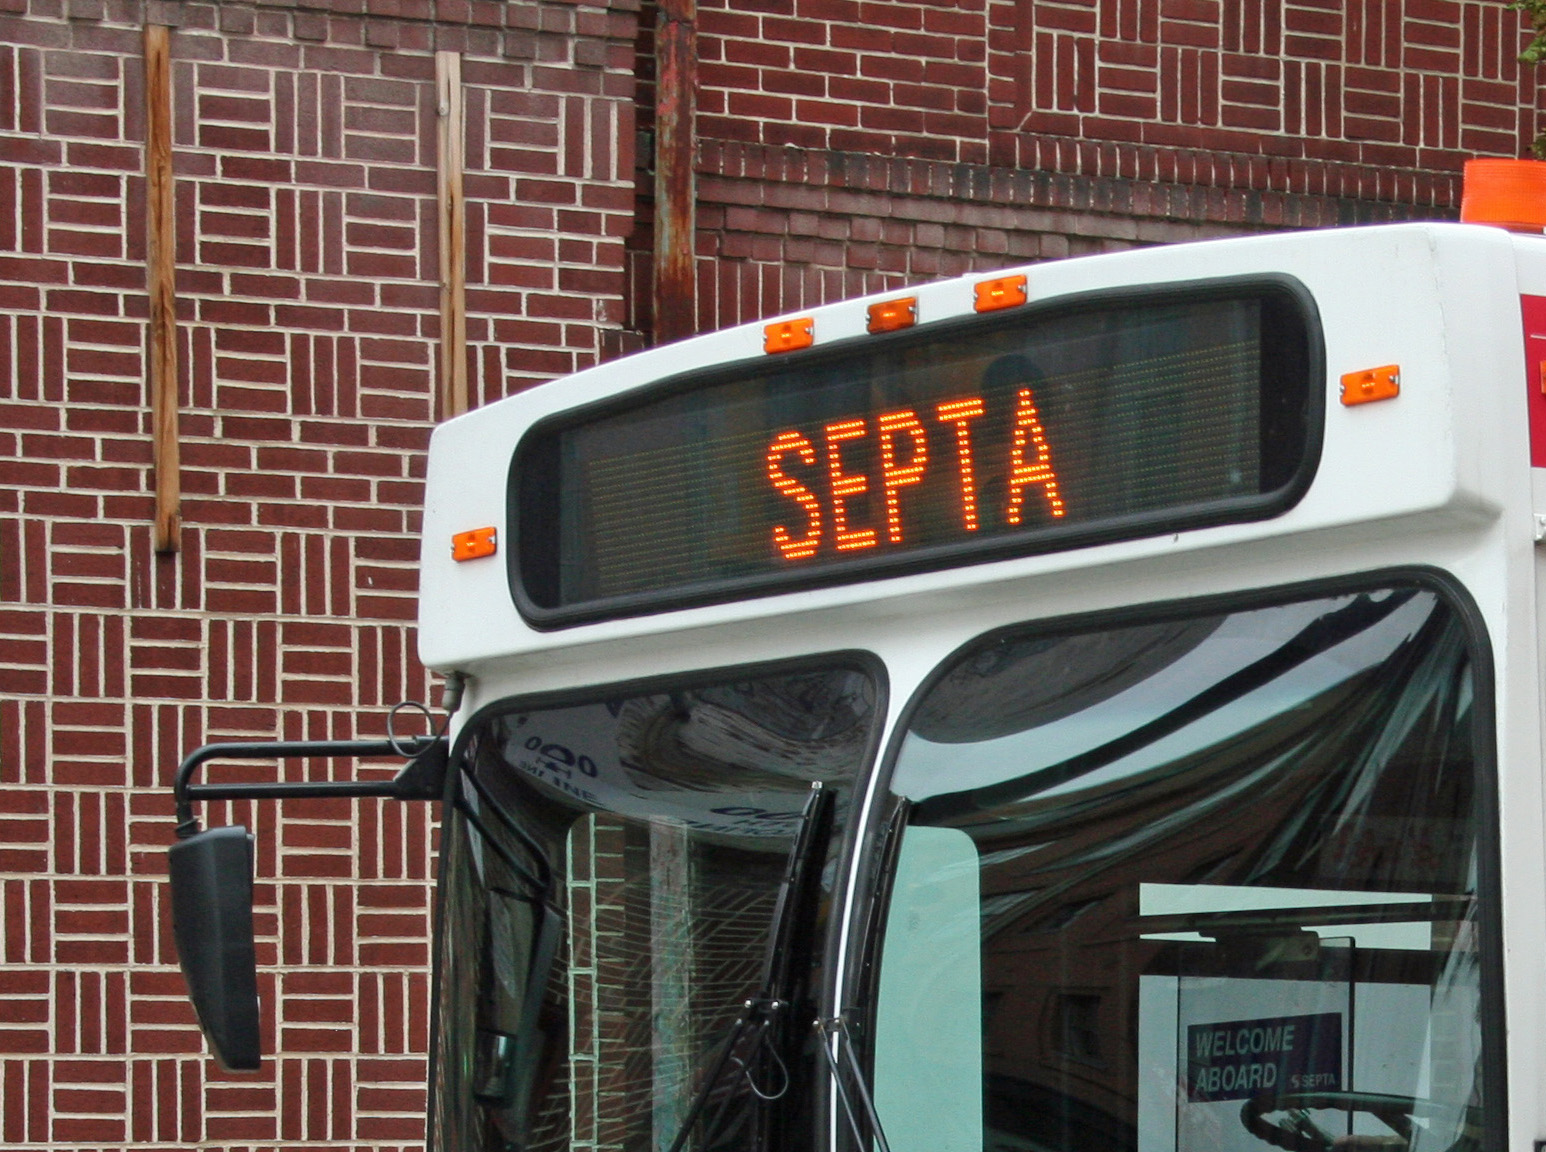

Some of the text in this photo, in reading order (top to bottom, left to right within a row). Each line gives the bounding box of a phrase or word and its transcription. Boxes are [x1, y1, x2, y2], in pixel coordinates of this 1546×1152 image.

[766, 385, 1066, 561] SEPTA
[1195, 1025, 1296, 1057] WELCOME
[1195, 1063, 1335, 1092] ABOARD SEPTA
